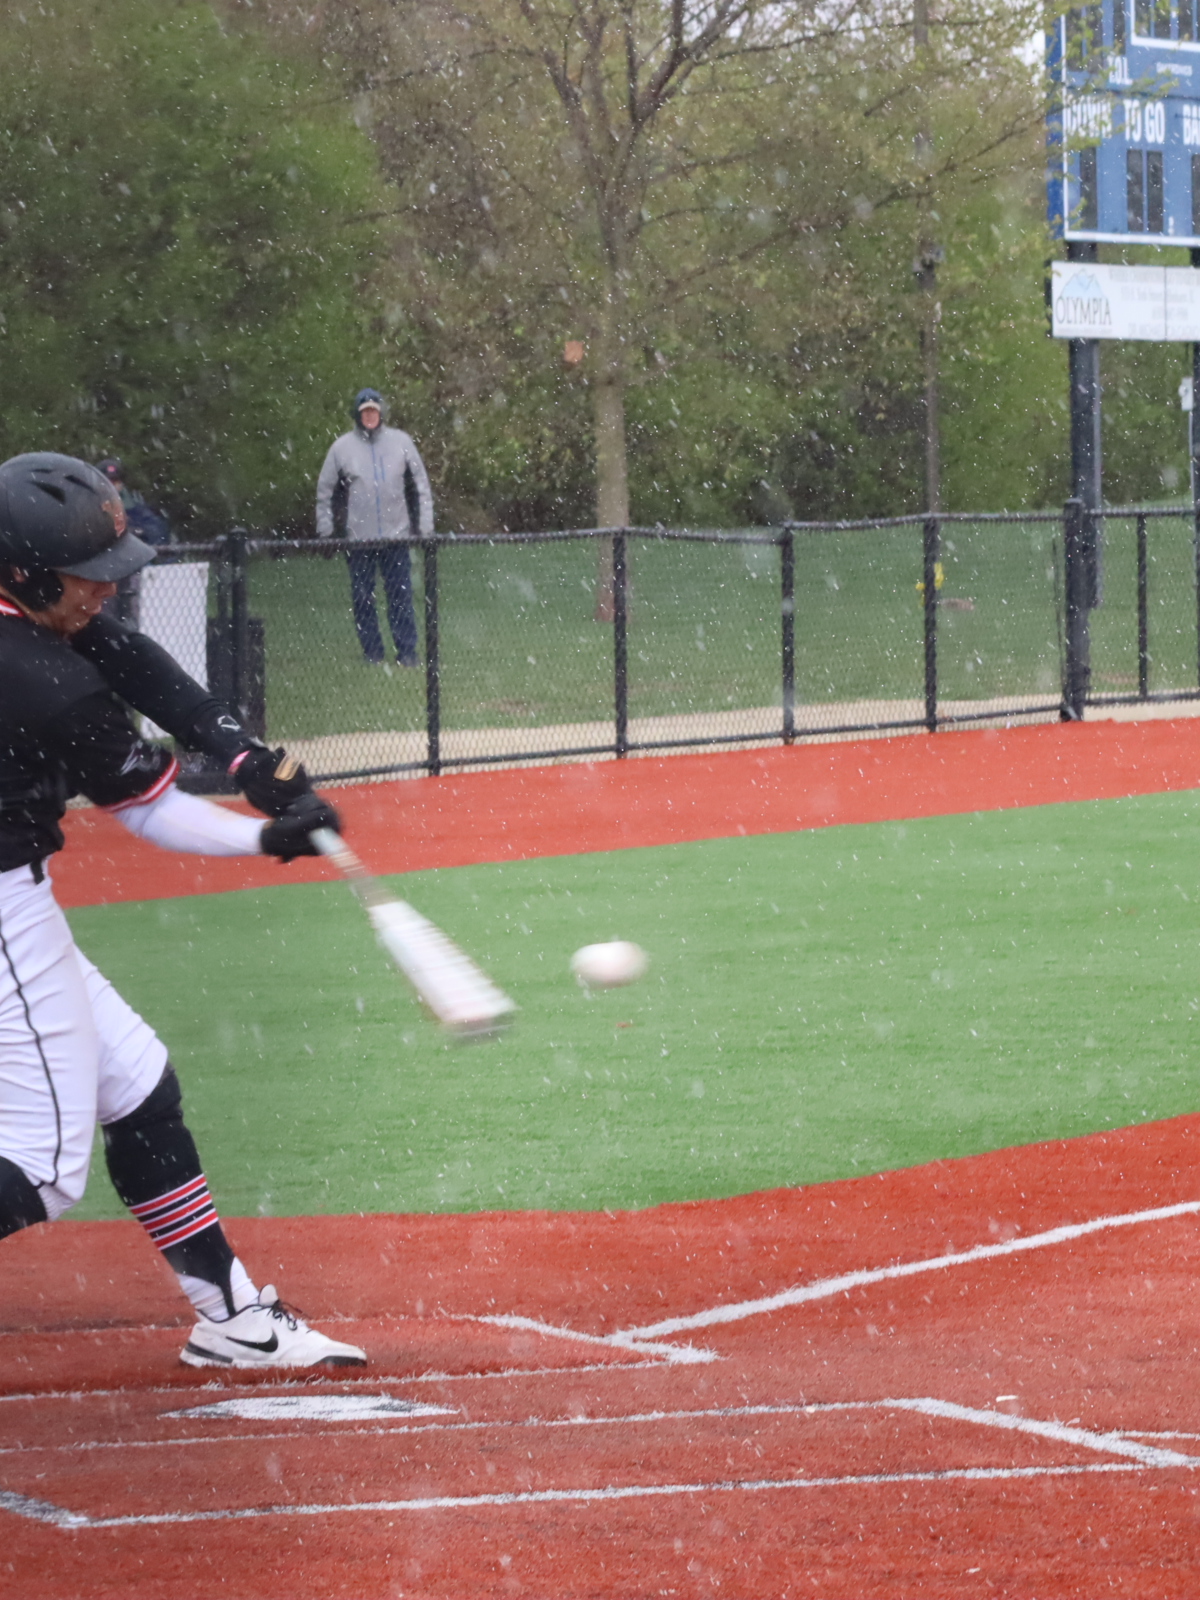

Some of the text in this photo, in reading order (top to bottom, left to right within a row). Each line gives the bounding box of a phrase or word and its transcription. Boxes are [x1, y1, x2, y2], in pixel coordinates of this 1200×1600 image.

[1123, 99, 1166, 145] TO GO
[1182, 104, 1200, 146] BA
[1055, 296, 1112, 326] OLYMPIA
